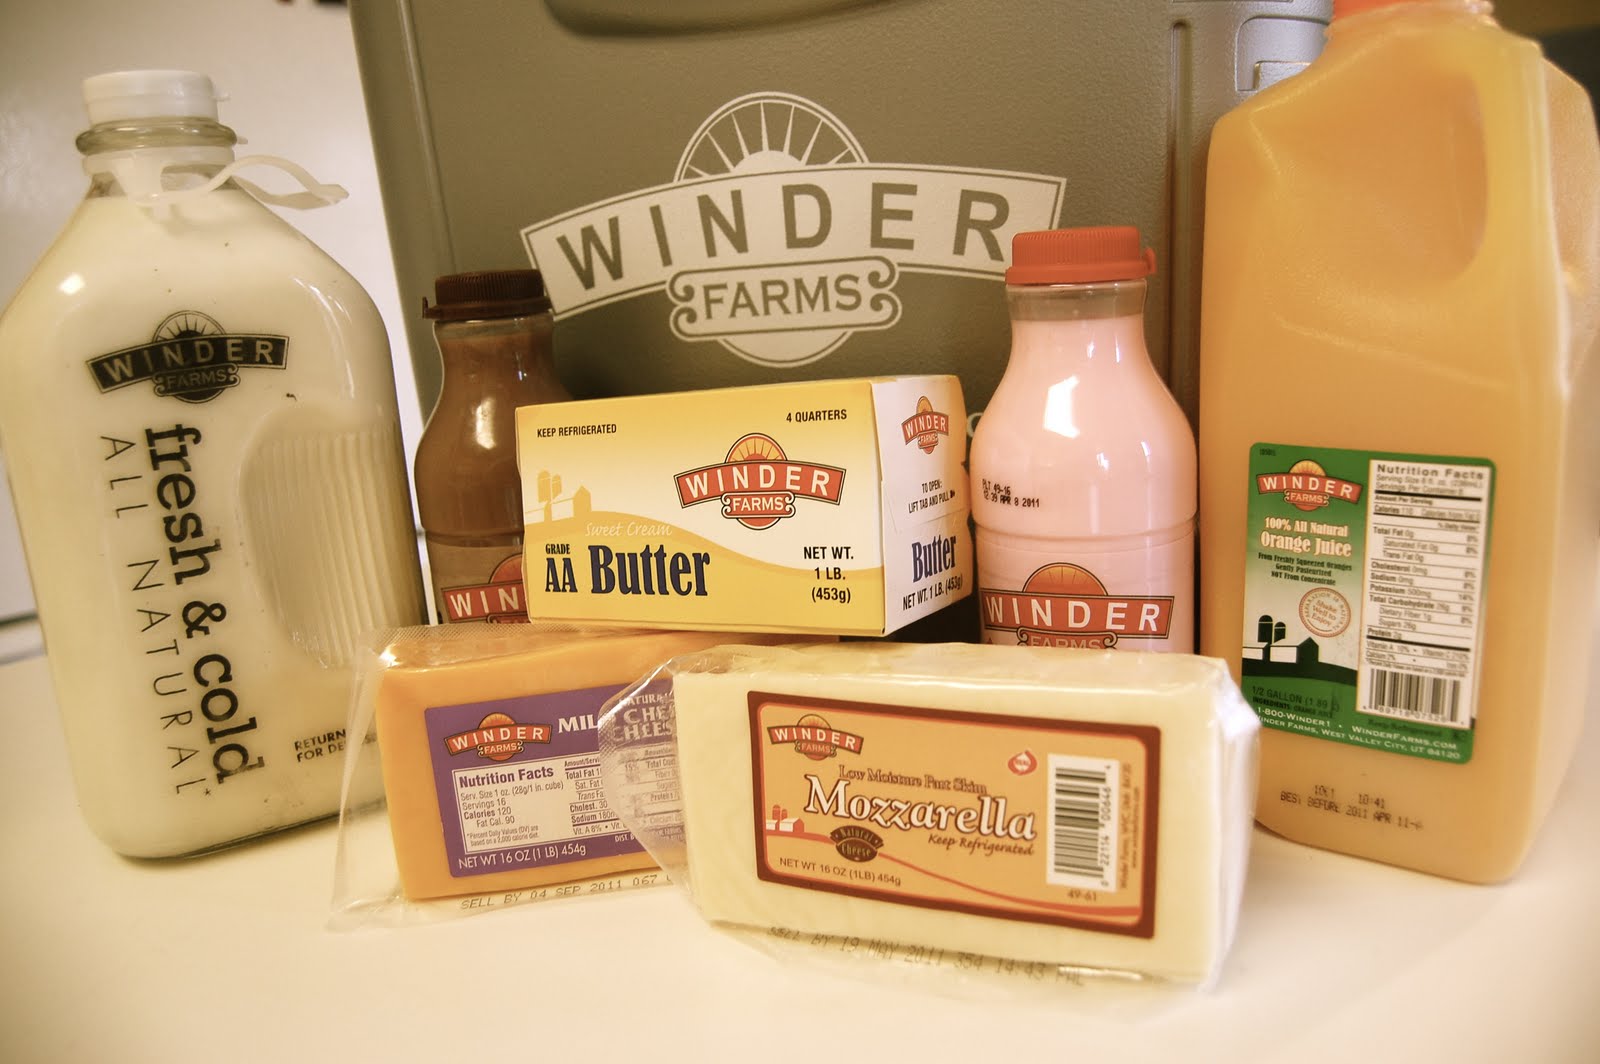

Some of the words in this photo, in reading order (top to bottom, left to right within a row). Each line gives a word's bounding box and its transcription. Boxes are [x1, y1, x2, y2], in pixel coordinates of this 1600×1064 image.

[556, 182, 1010, 290] WINDER
[702, 274, 862, 320] FARMS
[103, 339, 274, 383] WINDER
[166, 369, 227, 389] FARMS
[786, 412, 792, 422] 4
[795, 409, 847, 423] QUARTERS
[537, 427, 556, 438] KEEP
[558, 423, 617, 437] REFRIGERATED
[905, 415, 946, 438] WINDER
[920, 433, 936, 443] FARMS
[99, 435, 149, 520] ALL
[1377, 464, 1439, 477] Nutrition
[1445, 469, 1484, 480] Facts
[686, 464, 831, 500] WINDER
[922, 483, 928, 494] TO
[929, 479, 942, 492] OPEN:
[1263, 476, 1353, 499] WINDER
[145, 423, 221, 585] fresh
[732, 496, 785, 513] FARMS
[908, 500, 919, 514] LIFT
[920, 498, 928, 509] TAB
[929, 495, 939, 506] AND
[939, 491, 950, 504] PULL
[1014, 497, 1019, 506] 8
[1022, 497, 1039, 508] 2011
[1290, 493, 1323, 504] FARMS
[584, 521, 623, 538] Sweet
[627, 520, 673, 538] Cream
[1265, 516, 1292, 532] 100%
[1294, 520, 1307, 533] All
[1310, 522, 1349, 537] Natural
[545, 543, 571, 555] GRADE
[1261, 530, 1311, 554] Orange
[1314, 537, 1352, 557] Juice
[803, 547, 828, 561] NET
[830, 546, 854, 560] WT.
[911, 534, 956, 583] Butter
[1258, 552, 1273, 561] From
[1274, 554, 1295, 565] Freshly
[1296, 557, 1325, 569] Squeezed
[1326, 560, 1352, 571] Oranges
[545, 557, 578, 593] AA
[588, 543, 711, 597] Butter
[815, 567, 820, 580] 1
[825, 566, 846, 581] LB.
[1284, 572, 1299, 581] From
[1301, 574, 1336, 586] Concentrate
[1296, 566, 1331, 577] Pasteurized
[811, 587, 851, 604] (453g)
[903, 593, 916, 611] NET
[917, 587, 928, 605] WT.
[929, 585, 933, 599] 1
[934, 581, 944, 597] LB.
[945, 574, 963, 596] (453g)
[181, 599, 227, 639] &
[985, 596, 1161, 632] WINDER
[1266, 689, 1303, 704] GALLON
[193, 653, 264, 784] cold
[558, 714, 599, 734] MIL
[294, 729, 346, 751] RETURN
[452, 727, 544, 750] WINDER
[774, 727, 857, 749] WINDER
[297, 748, 323, 763] FOR
[484, 743, 517, 754] FARMS
[801, 743, 831, 754] FARMS
[1410, 745, 1426, 754] UT
[459, 772, 515, 788] Nutrition
[518, 766, 554, 780] Facts
[565, 769, 582, 780] Total
[583, 768, 593, 777] Fat
[589, 779, 600, 788] Fat
[838, 764, 866, 780] Low
[867, 768, 922, 787] Moisture
[924, 774, 951, 790] Part
[953, 777, 988, 795] Skim
[461, 792, 477, 801] Serv.
[479, 790, 493, 799] Size
[512, 784, 533, 797] (28g/1
[535, 783, 543, 791] in.
[545, 781, 564, 790] cube)
[577, 791, 595, 801] Trans
[462, 800, 495, 811] Servings
[497, 798, 506, 807] 16
[464, 809, 495, 820] Calories
[497, 806, 512, 816] 120
[569, 802, 597, 813] Cholest.
[803, 772, 1038, 842] Mozzarella
[476, 818, 488, 828] Fat
[490, 817, 504, 826] Cal.
[505, 815, 515, 825] 90
[571, 814, 597, 824] Sodium
[489, 829, 500, 838] Daily
[502, 827, 518, 835] Values
[839, 827, 874, 843] Natural
[840, 842, 871, 858] Cheese
[928, 833, 957, 848] Keep
[959, 838, 1035, 856] Refrigerated
[458, 855, 478, 870] NET
[480, 854, 498, 866] WT
[500, 852, 512, 864] 16
[515, 849, 531, 861] OZ
[532, 847, 541, 861] (1
[545, 845, 559, 858] LB)
[561, 842, 587, 856] 454g
[779, 857, 799, 868] NET
[801, 860, 817, 872] WT
[819, 863, 831, 874] 16
[833, 866, 847, 877] OZ
[849, 868, 876, 882] (1LB)
[877, 872, 901, 887] 454g
[460, 898, 494, 909] SELL
[504, 893, 522, 904] BY
[530, 889, 547, 899] 04
[556, 885, 581, 897] SEP
[590, 880, 622, 892] 2011
[632, 875, 657, 886] 067
[868, 940, 900, 961] MAY
[904, 944, 945, 967] 2011
